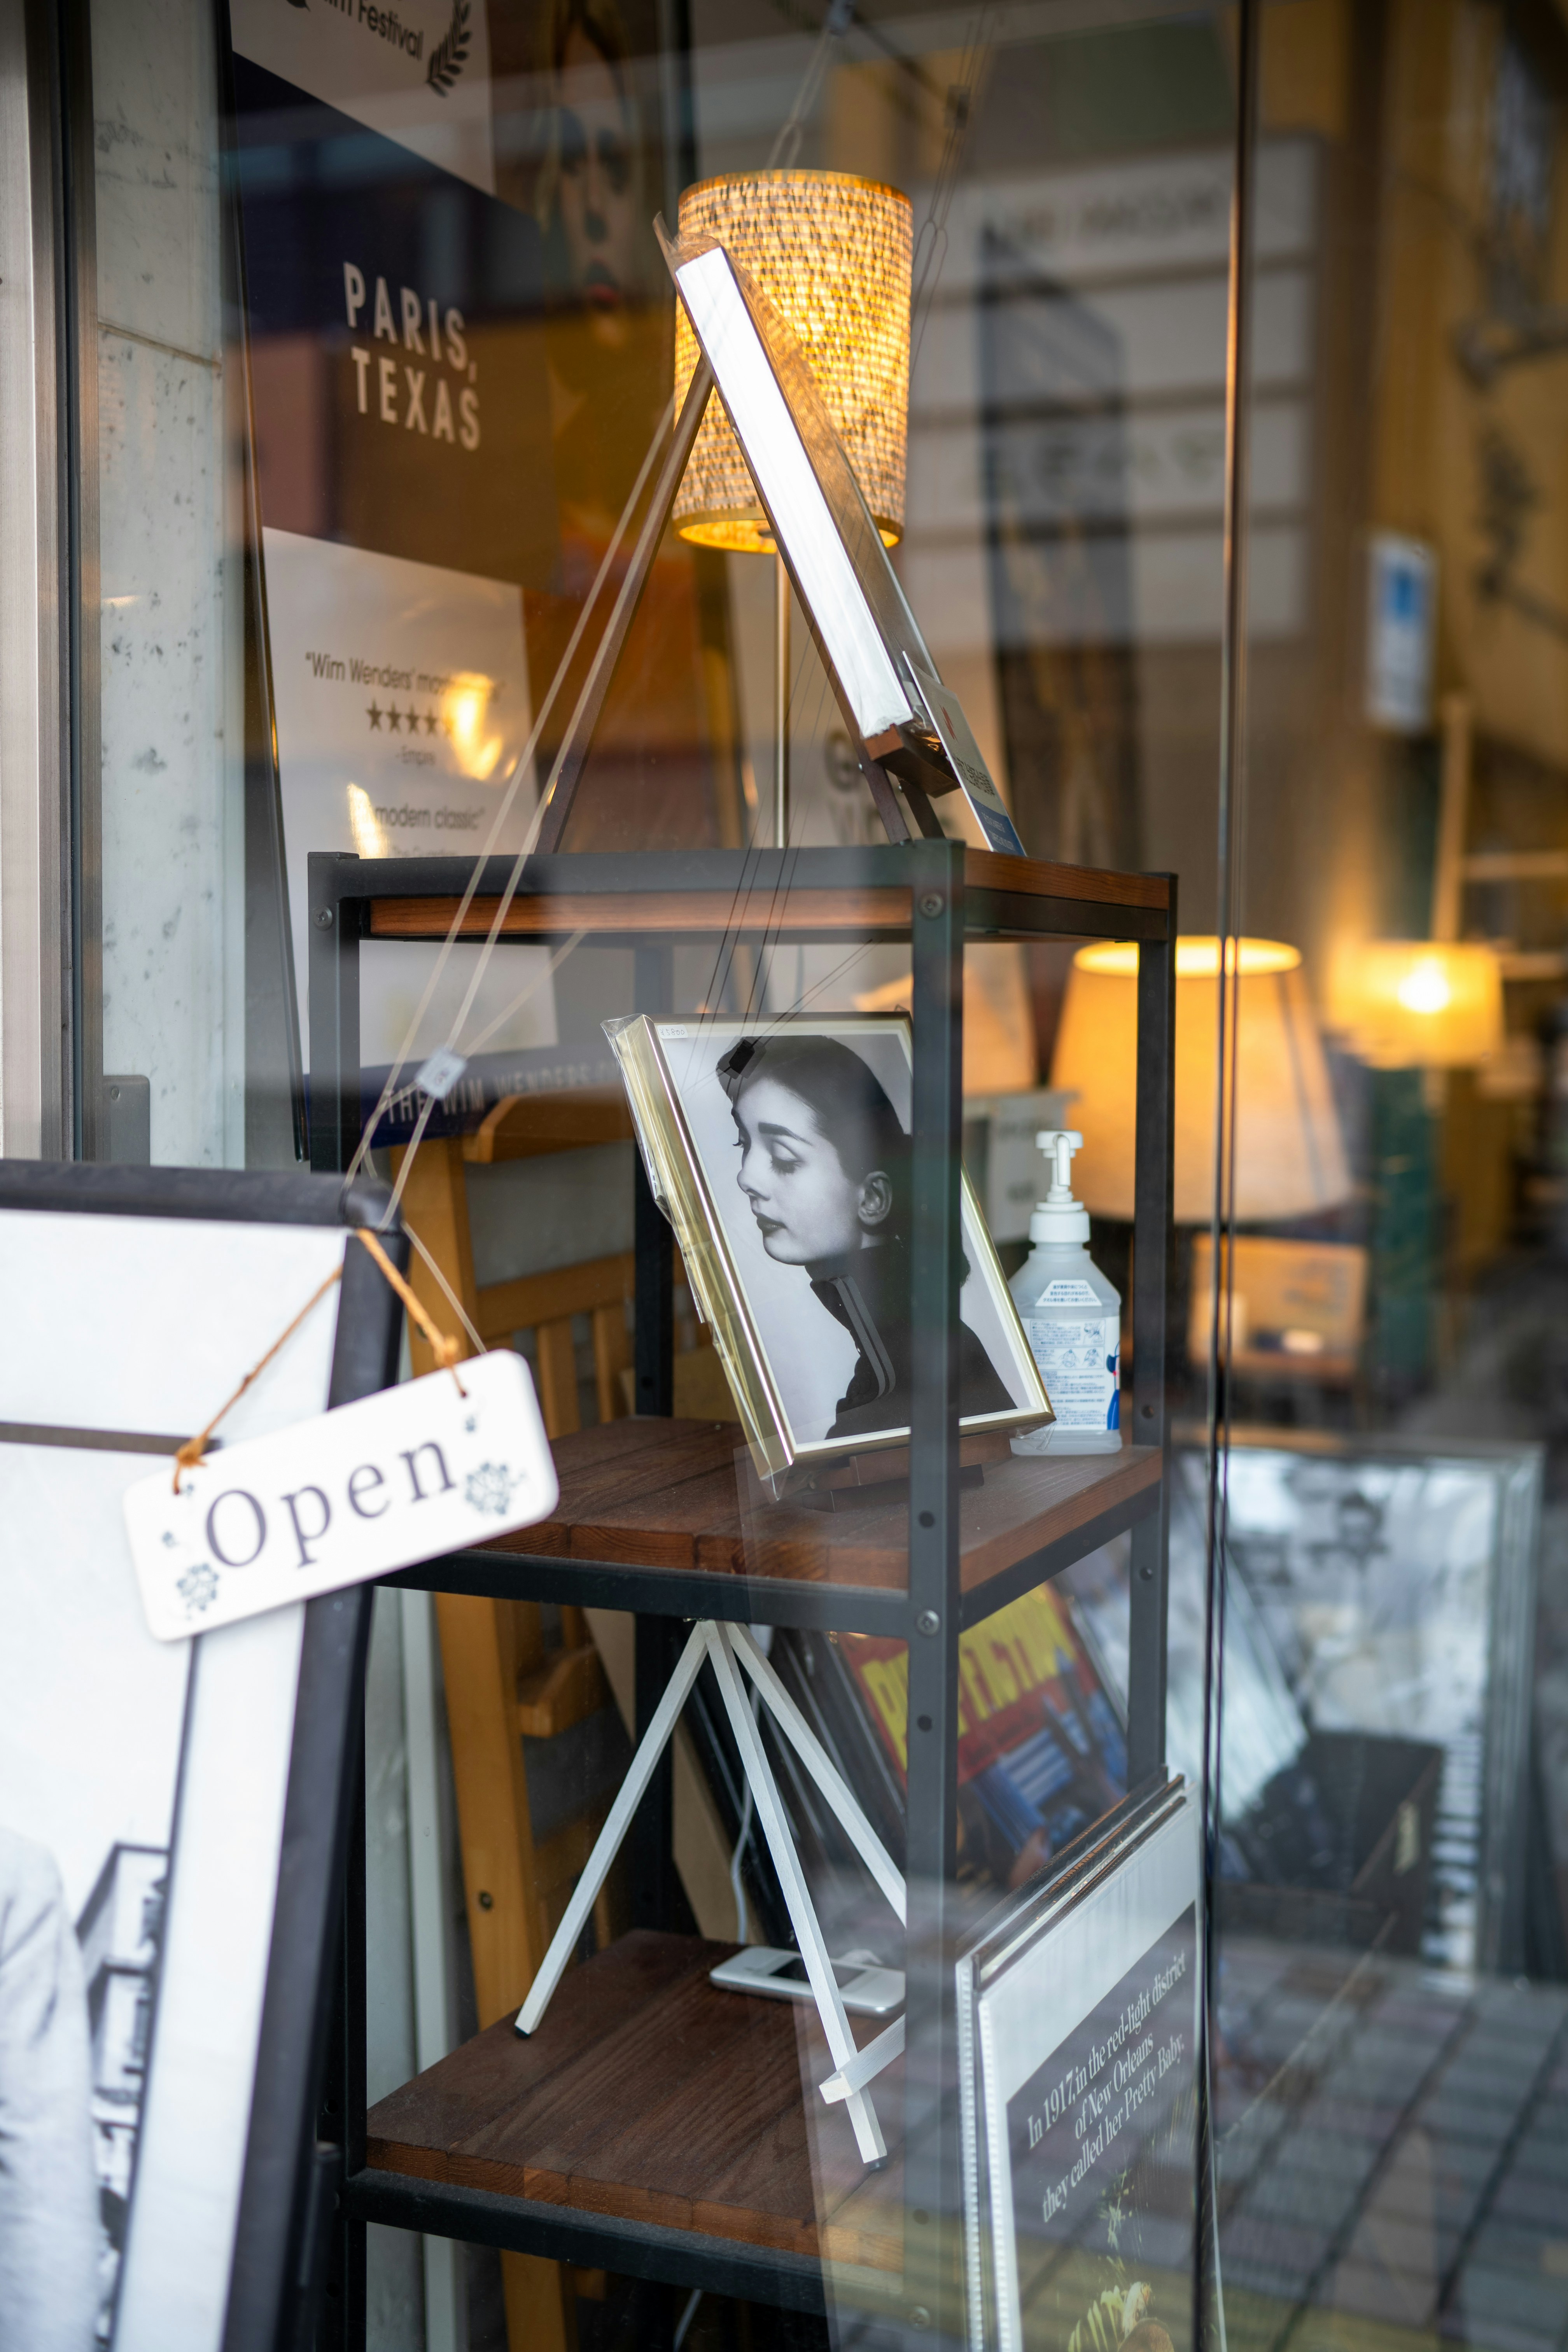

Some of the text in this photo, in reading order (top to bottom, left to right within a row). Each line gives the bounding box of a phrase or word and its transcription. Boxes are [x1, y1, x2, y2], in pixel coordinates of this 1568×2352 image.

[358, 0, 424, 61] Festival
[343, 261, 478, 383] PARIS,
[351, 345, 480, 452] TEXAS
[375, 802, 430, 828] modern
[206, 1440, 457, 1568] Open
[1028, 1948, 1185, 2149] In 1917, in the red-light district
[1075, 2032, 1153, 2139] of New Orleans
[1043, 2034, 1185, 2223] they called her Pretty Baby.
